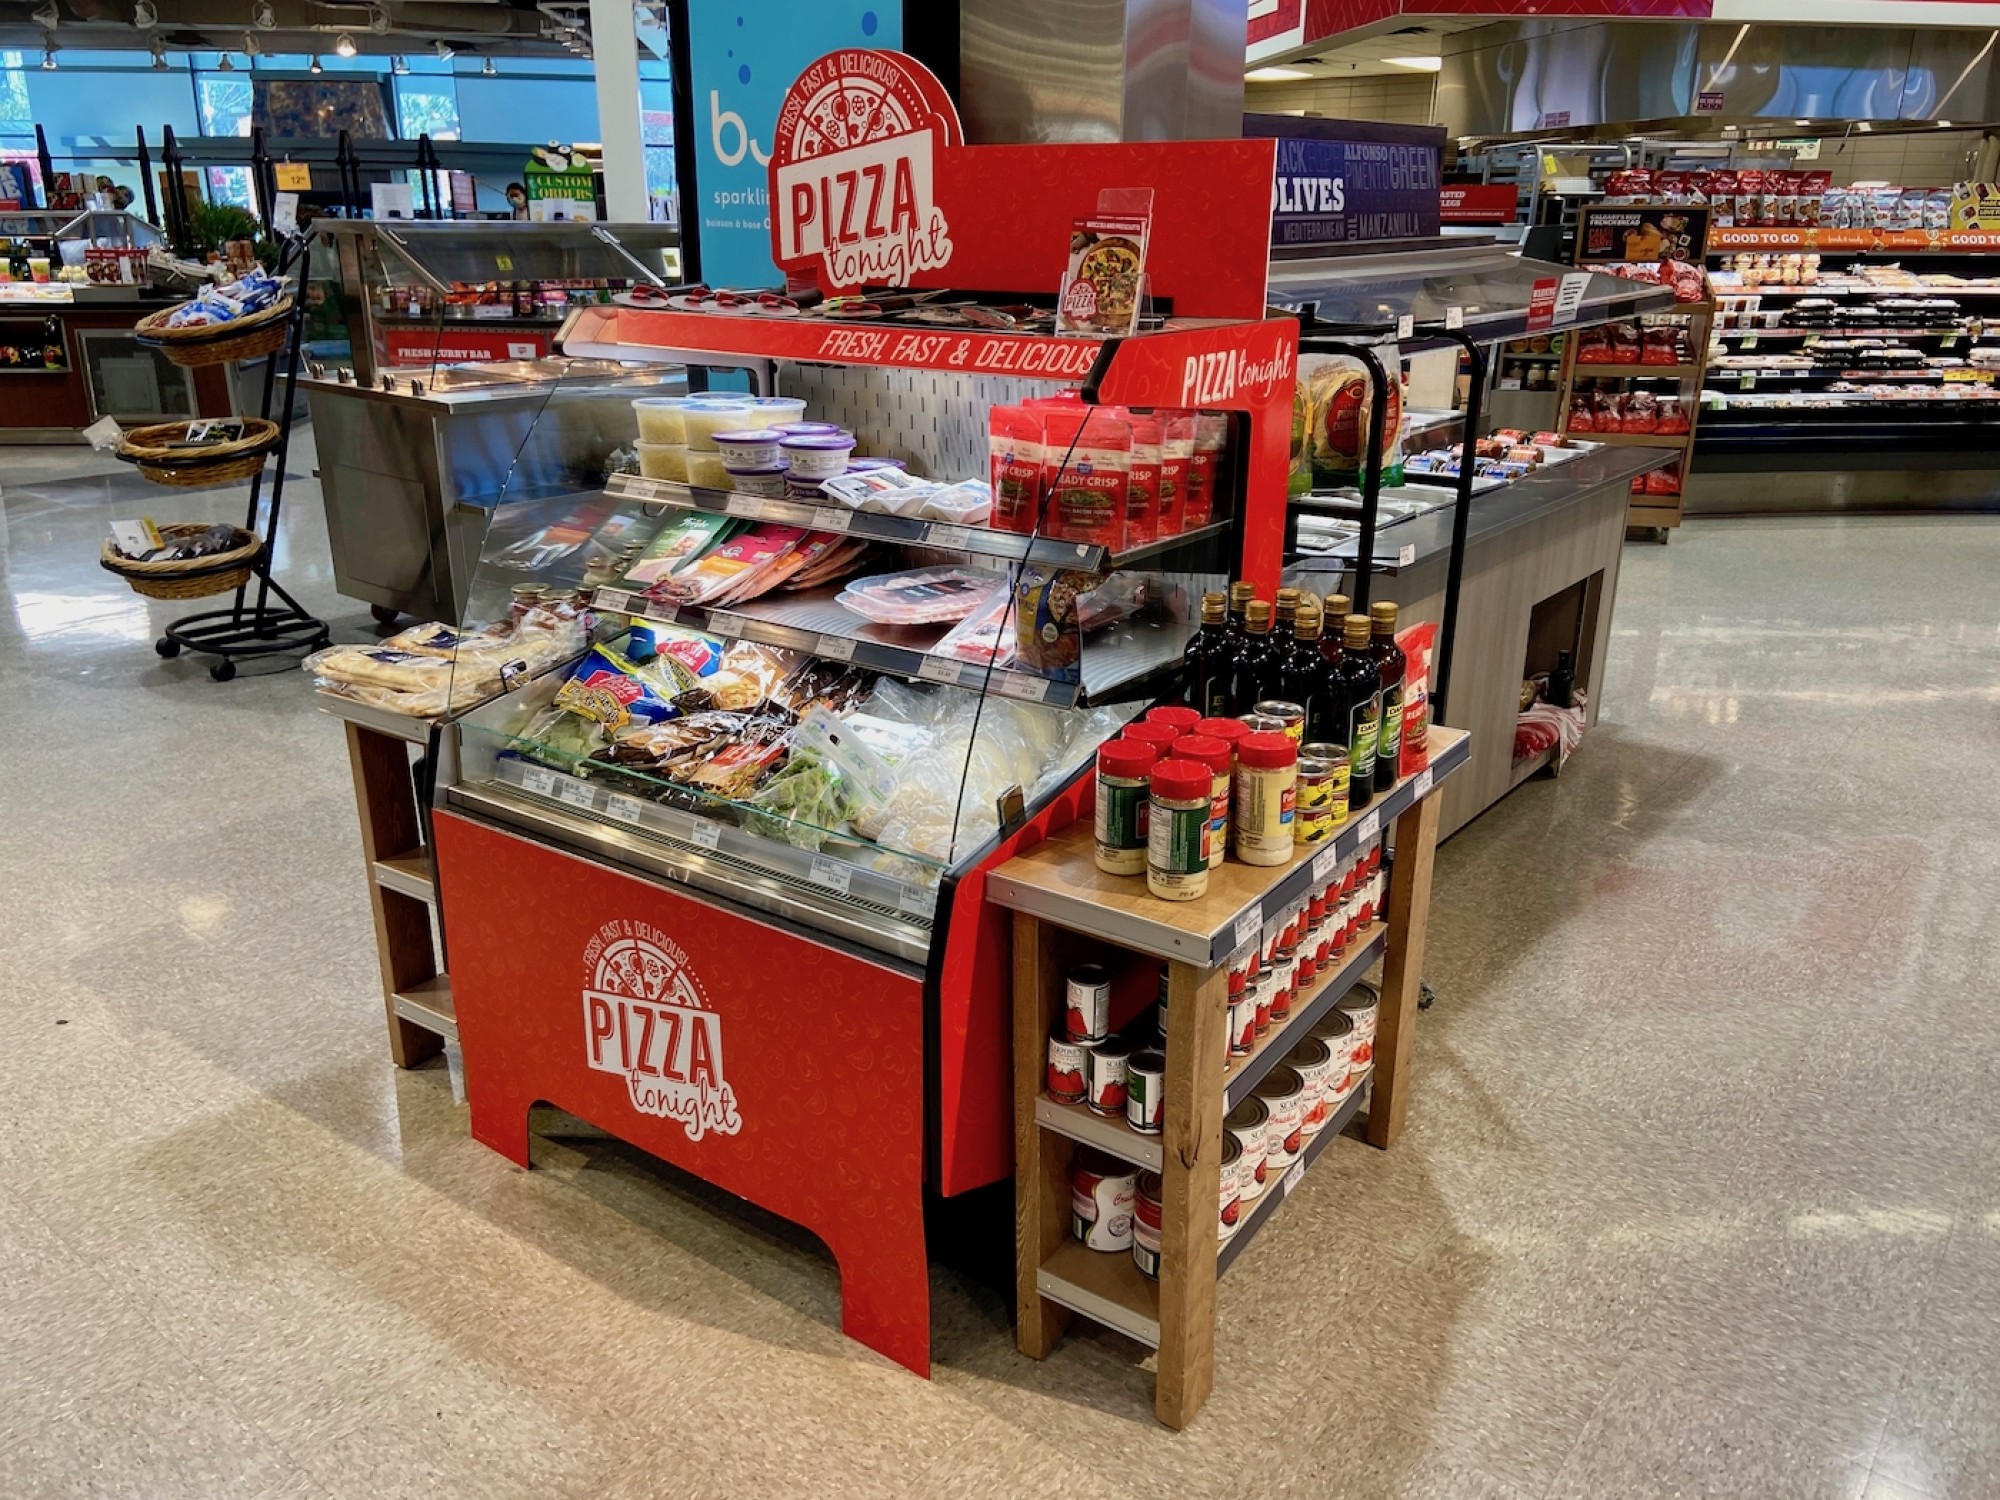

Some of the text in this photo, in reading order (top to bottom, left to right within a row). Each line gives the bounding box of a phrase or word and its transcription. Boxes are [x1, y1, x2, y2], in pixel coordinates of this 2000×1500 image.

[800, 68, 825, 101] FAST
[826, 58, 838, 76] &
[840, 53, 902, 89] DELICIOUS!
[1344, 144, 1389, 161] ALFONSO
[536, 175, 594, 188] CUSTOM
[1345, 162, 1390, 191] PIMENTO
[1389, 147, 1437, 190] GREEN
[537, 187, 595, 201] ORDERS
[791, 156, 922, 257] PIZZA
[1283, 219, 1345, 241] MEDITERRANEAN
[1358, 212, 1421, 239] MANZANILLA
[1722, 233, 1800, 244] GOOD TO GO
[1951, 234, 1988, 245] GOOD
[828, 213, 949, 288] tonight
[397, 348, 491, 359] FRESH CURRY BAR
[818, 329, 882, 360] FRESH,
[890, 334, 950, 363] FAST
[952, 338, 970, 365] &
[1182, 339, 1292, 408] PIZZA tonight
[1010, 468, 1034, 479] CRISP
[1087, 476, 1119, 488] CRISP
[599, 919, 624, 943] FAST
[624, 919, 633, 935] &
[635, 919, 690, 966] DELICIOUS!
[589, 997, 719, 1091] PIZZA
[628, 1067, 738, 1135] tonight
